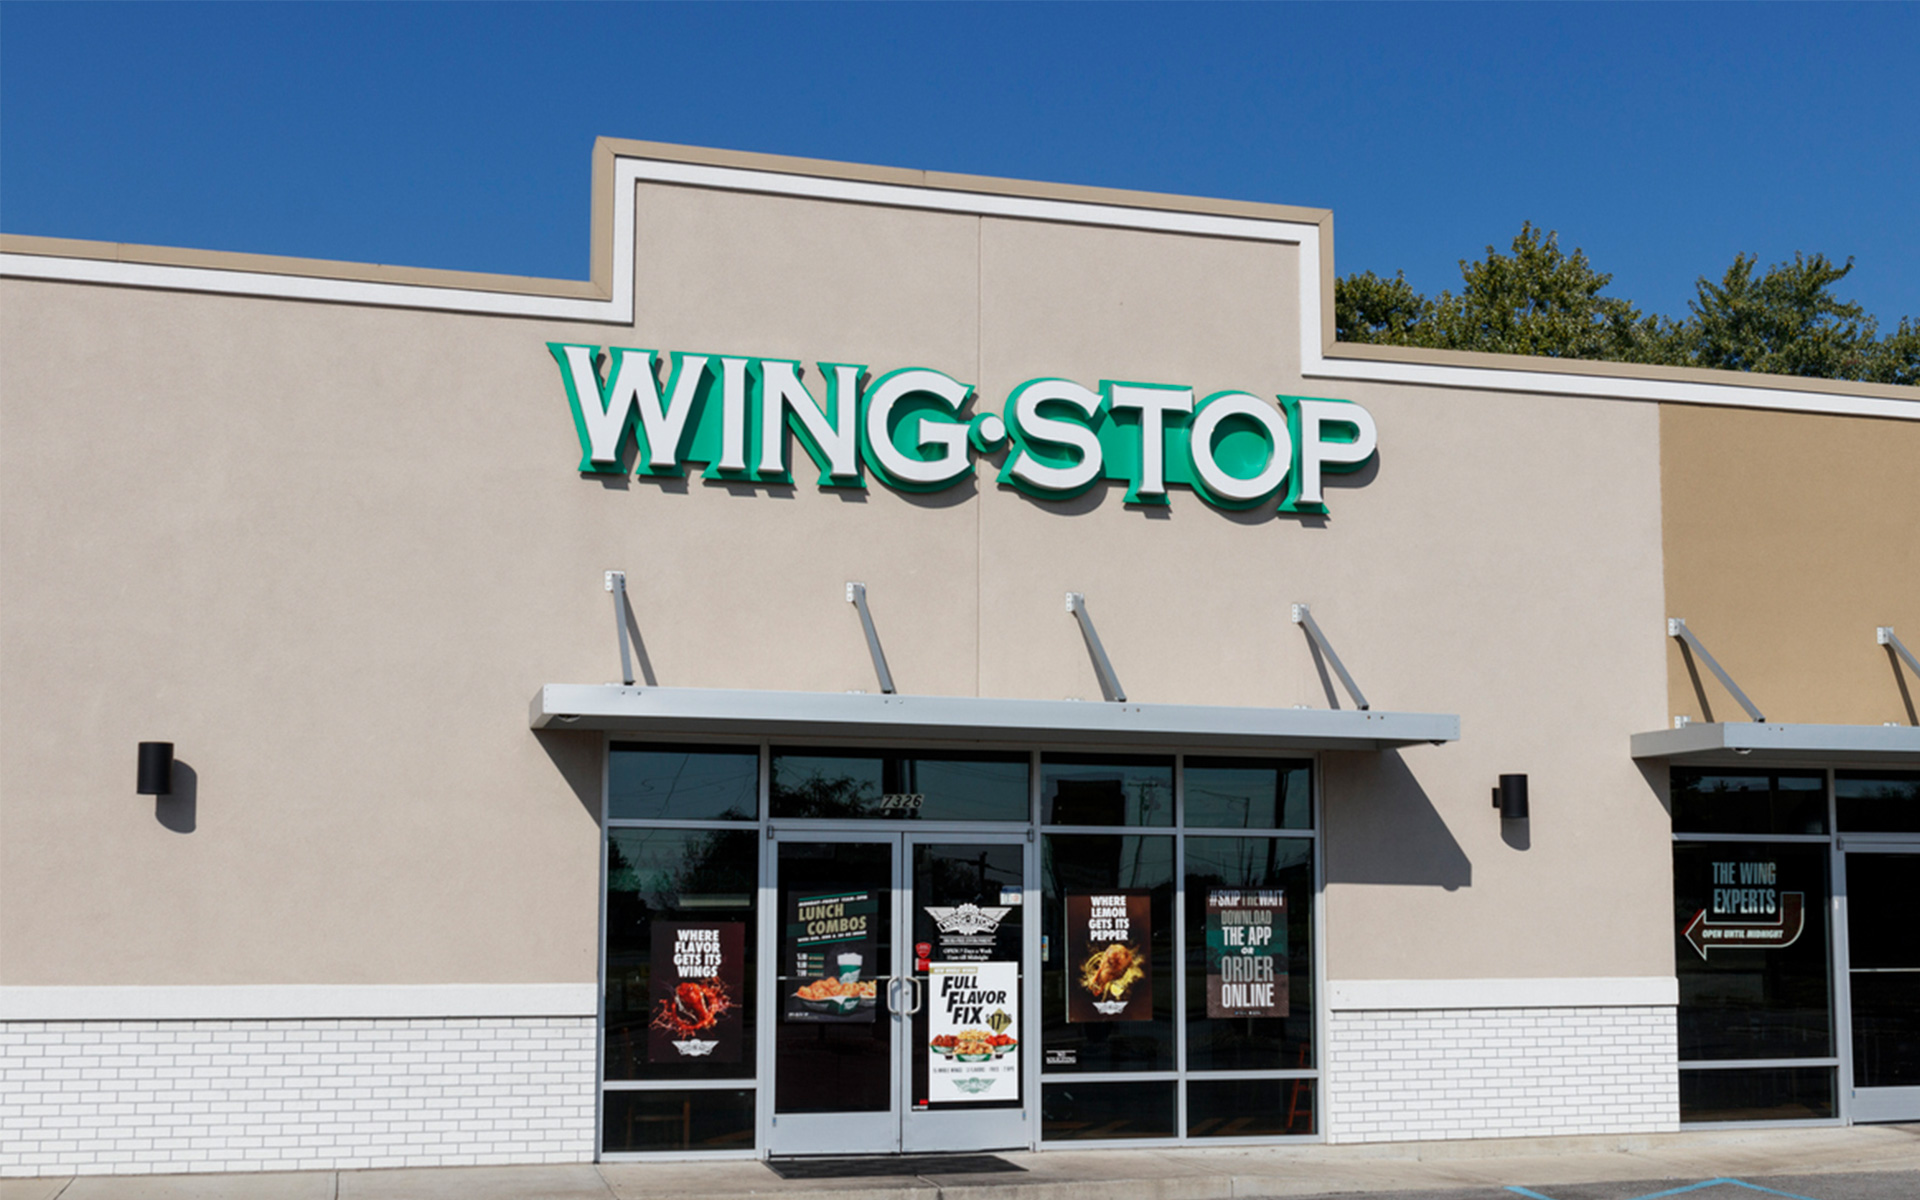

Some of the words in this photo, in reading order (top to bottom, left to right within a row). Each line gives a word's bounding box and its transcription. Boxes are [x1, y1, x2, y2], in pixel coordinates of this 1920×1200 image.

[881, 794, 924, 808] 7326
[1712, 862, 1736, 885] THE
[1740, 862, 1776, 885] WING
[1090, 895, 1127, 907] WHERE
[1713, 888, 1776, 914] EXPERTS
[798, 903, 845, 922] LUNCH
[1091, 907, 1127, 918] LEMON
[1221, 910, 1272, 925] DOWNLOAD
[807, 916, 867, 935] COMBOS
[1088, 918, 1112, 930] GETS
[1115, 918, 1130, 929] ITS
[677, 929, 719, 941] WHERE
[1090, 930, 1128, 942] PEPPER
[1221, 926, 1245, 946] THE
[1247, 926, 1272, 946] APP
[1702, 929, 1722, 939] OPEN
[1723, 929, 1745, 939] UNTIL
[1746, 929, 1784, 939] MIDNIGHT
[674, 942, 720, 953] FLAVOR
[1240, 947, 1254, 955] OR
[673, 954, 702, 965] GETS
[704, 954, 721, 965] ITS
[677, 966, 718, 977] WINGS
[1221, 956, 1274, 983] ORDER
[941, 976, 978, 997] FULL
[947, 991, 1007, 1012] FLAVOR
[1221, 983, 1275, 1008] ONLINE
[952, 1007, 983, 1025] FIX
